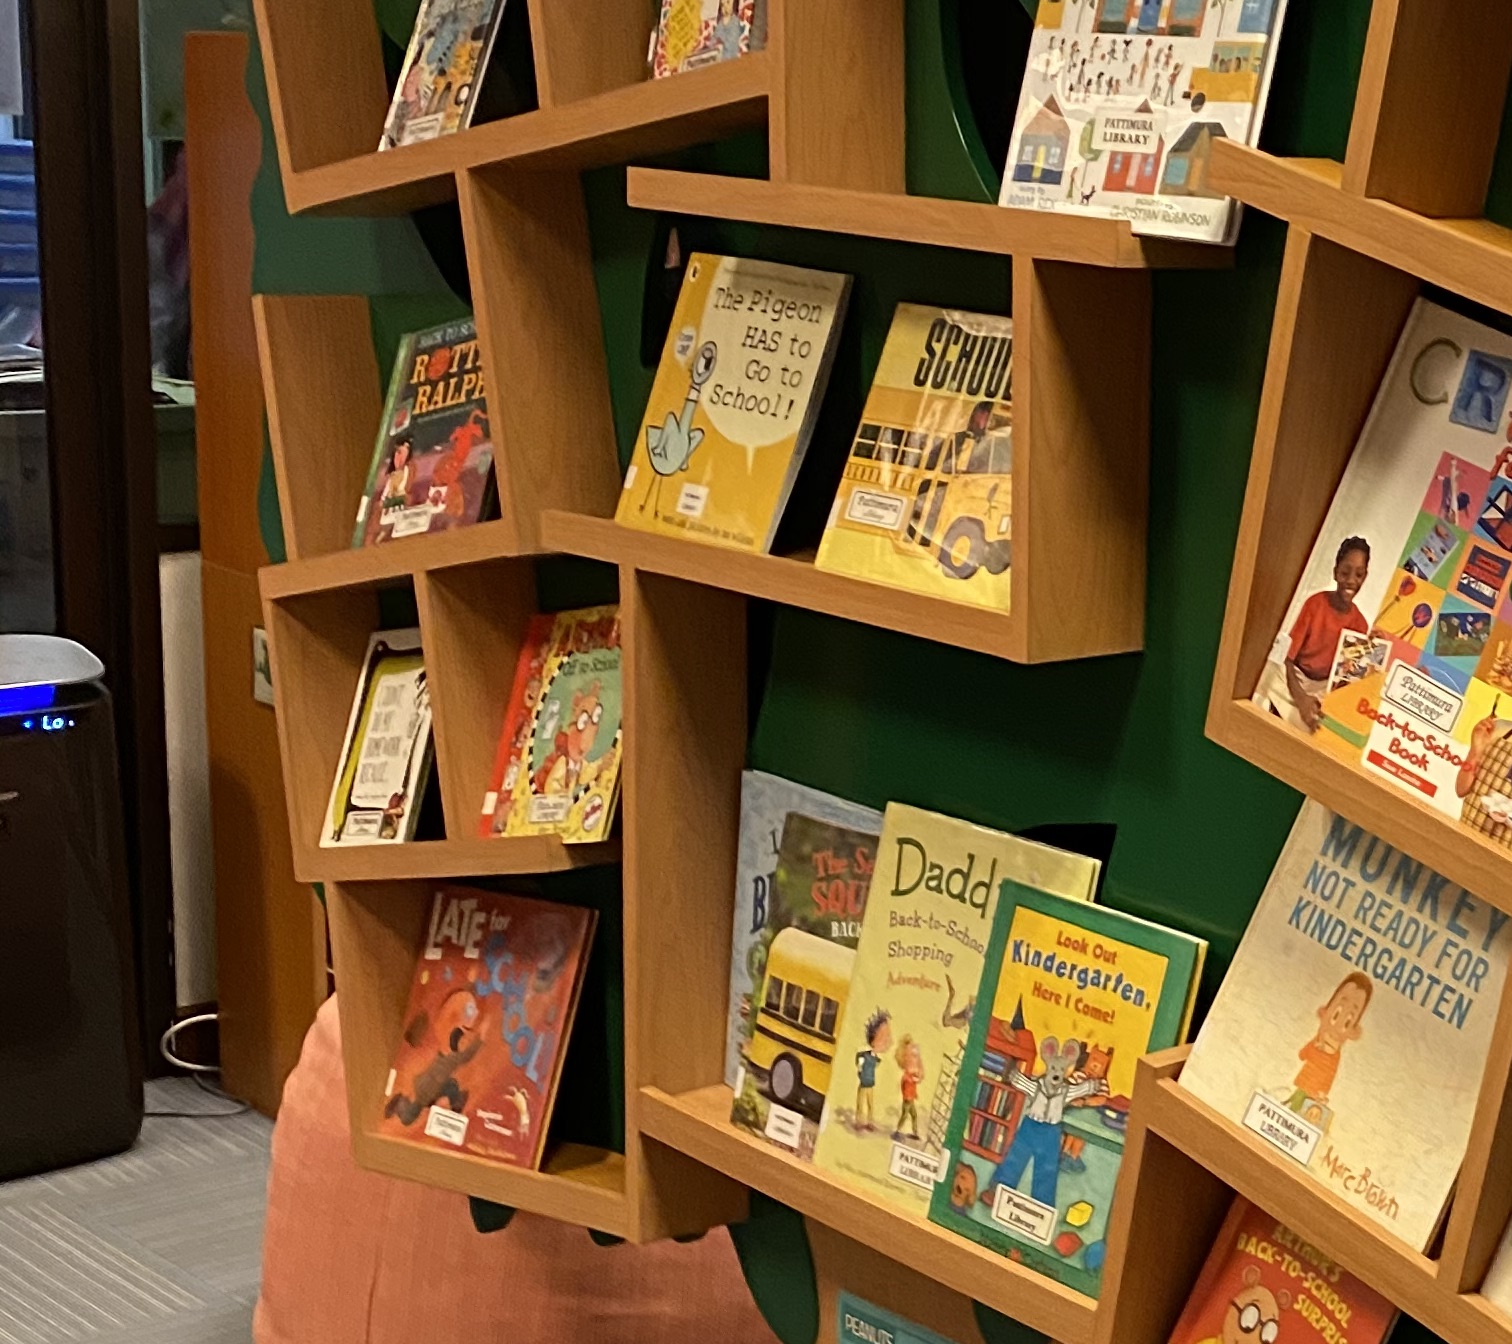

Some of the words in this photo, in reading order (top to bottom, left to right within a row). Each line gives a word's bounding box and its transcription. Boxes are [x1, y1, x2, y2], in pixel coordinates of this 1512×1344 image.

[1103, 117, 1154, 132] PATTIMURA
[1103, 131, 1150, 146] LIBRARY
[713, 287, 744, 311] The
[747, 289, 823, 323] Pigeon
[742, 325, 782, 353] HAS
[789, 333, 812, 359] to
[745, 359, 771, 382] Go
[781, 364, 803, 388] to
[709, 383, 795, 420] School!
[1388, 737, 1429, 771] Book
[891, 837, 1001, 919] Dadd
[811, 879, 870, 919] SQU
[424, 891, 487, 960] LATE
[888, 909, 985, 955] Back-to-Schoo
[1303, 860, 1356, 910] NOT
[1354, 889, 1438, 958] READY
[1435, 938, 1489, 993] FOR
[888, 939, 954, 967] Shopping
[1056, 931, 1089, 955] Look
[1093, 943, 1118, 965] Out
[1288, 896, 1473, 1030] KINDERGARTEN
[1012, 939, 1151, 1011] Kindergarten,
[1032, 981, 1062, 1006] Here
[1065, 993, 1071, 1008] I
[1074, 996, 1116, 1024] Come!
[1258, 1103, 1310, 1144] PATTIMURA
[1237, 1233, 1352, 1329] BACK-TO-SCHOOL
